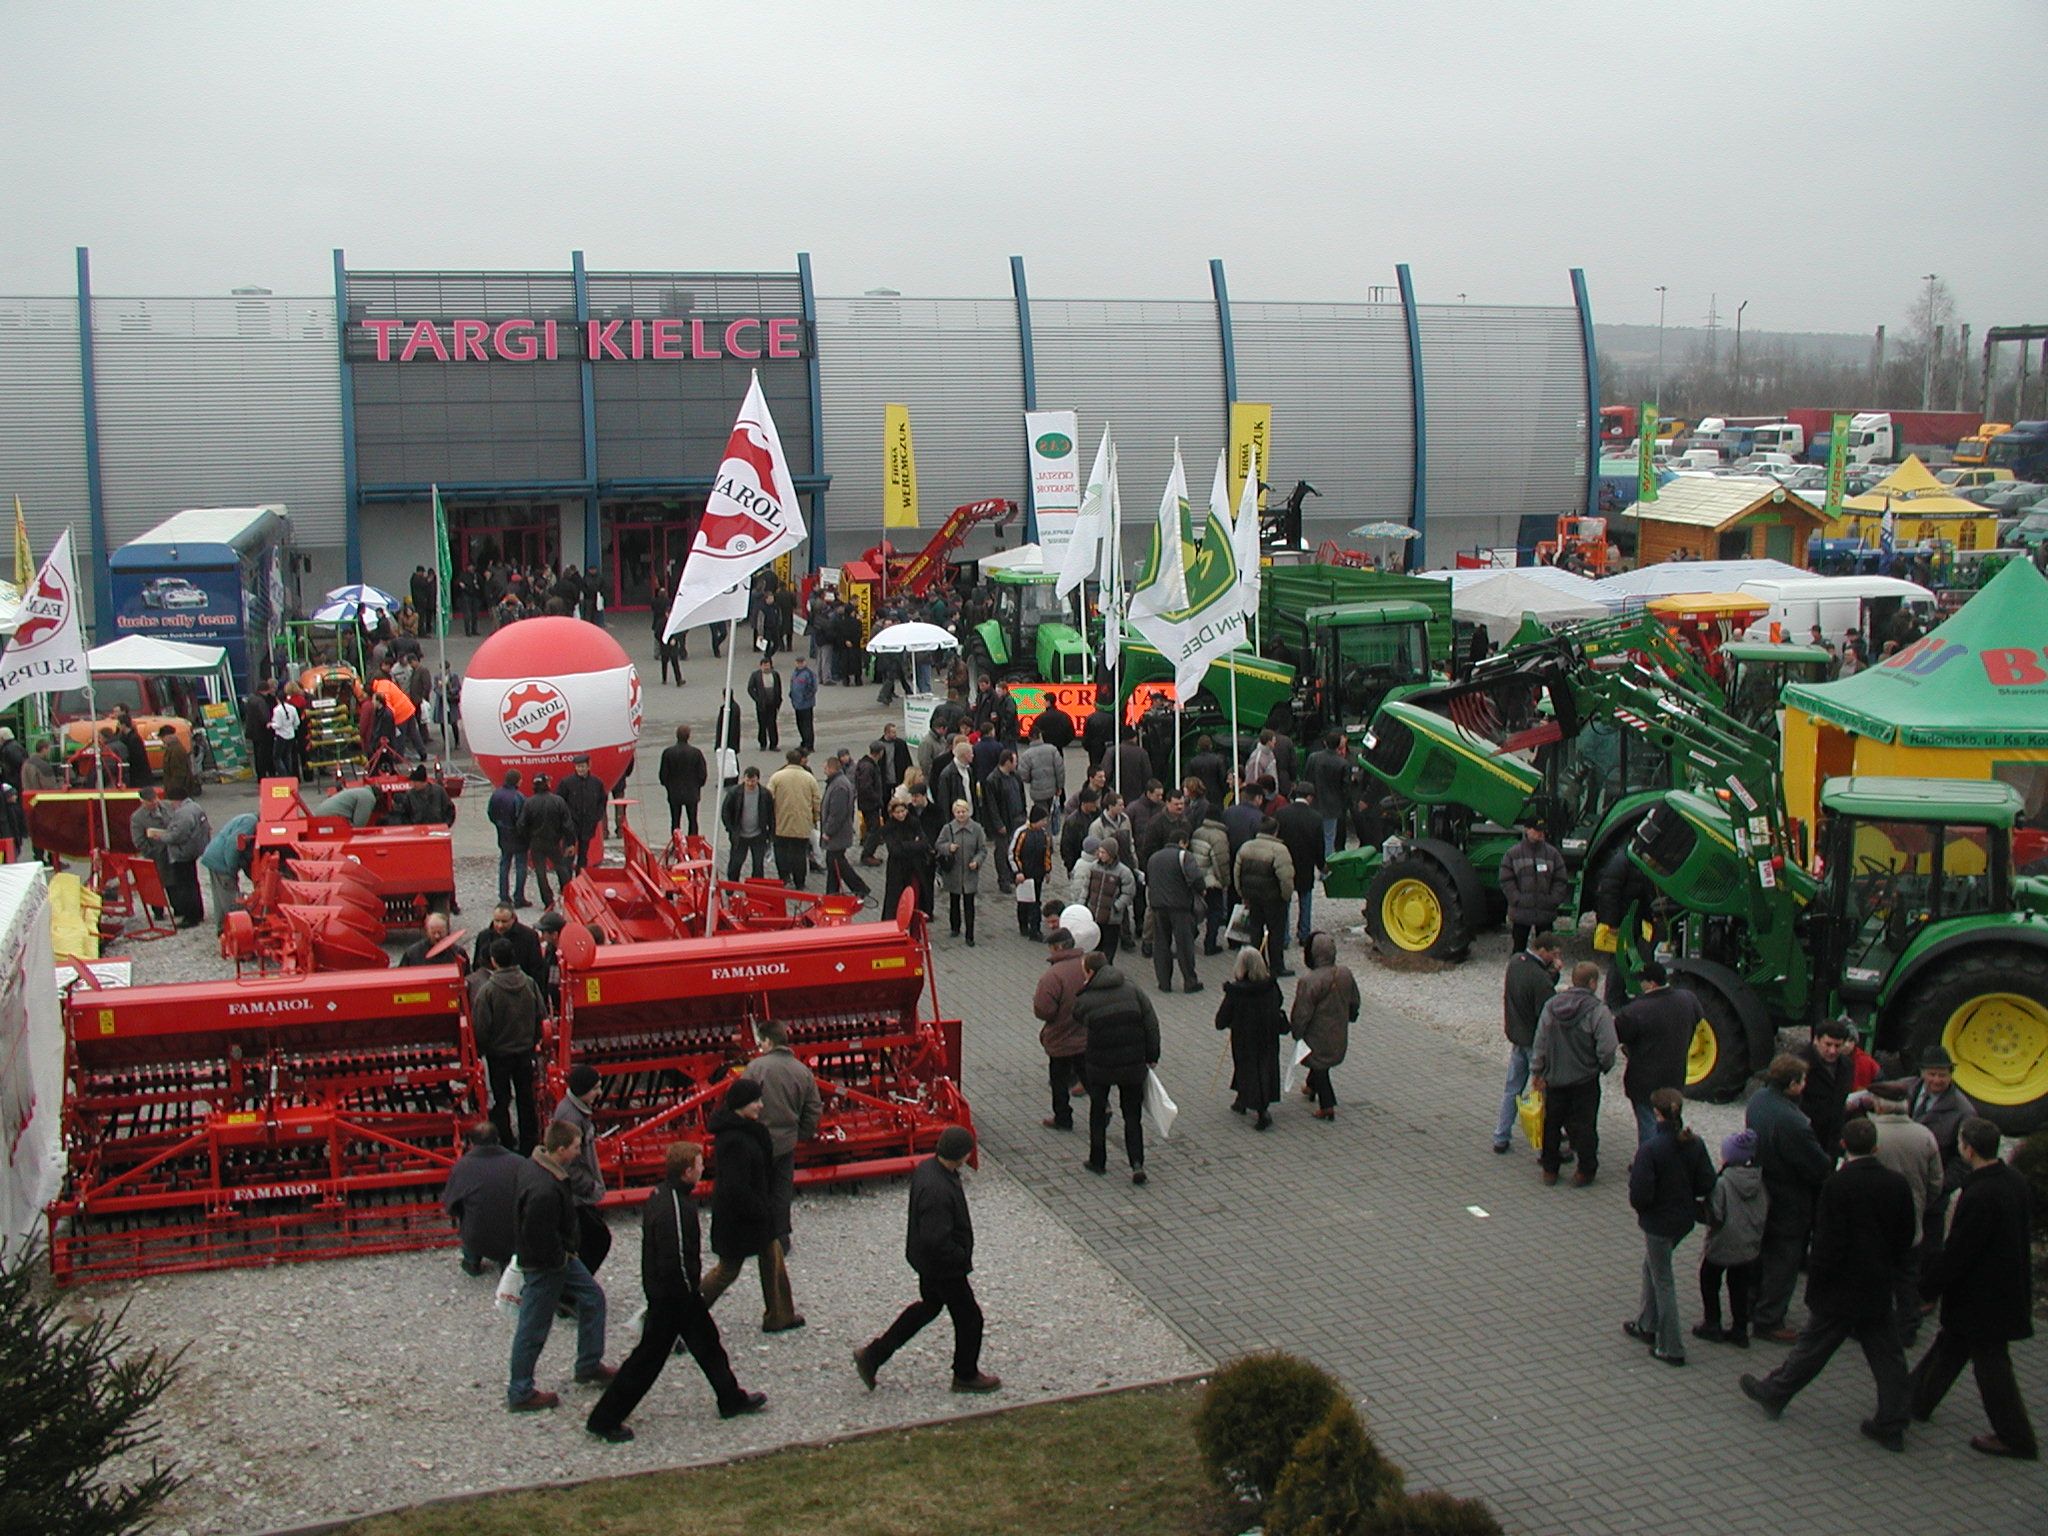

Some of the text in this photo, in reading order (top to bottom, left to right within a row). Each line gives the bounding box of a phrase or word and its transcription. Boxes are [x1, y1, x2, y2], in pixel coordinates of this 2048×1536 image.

[361, 318, 801, 361] TARGI KIELCE
[891, 446, 899, 485] FIRMA
[899, 422, 911, 508] WEREMCZUK
[1239, 443, 1249, 479] FIRMA
[161, 614, 195, 628] rally
[198, 614, 237, 625] team
[505, 700, 563, 734] FAMAROL
[711, 963, 789, 979] FAMAROL
[229, 999, 313, 1014] FAMAROL
[235, 1184, 322, 1201] FAMAROL
